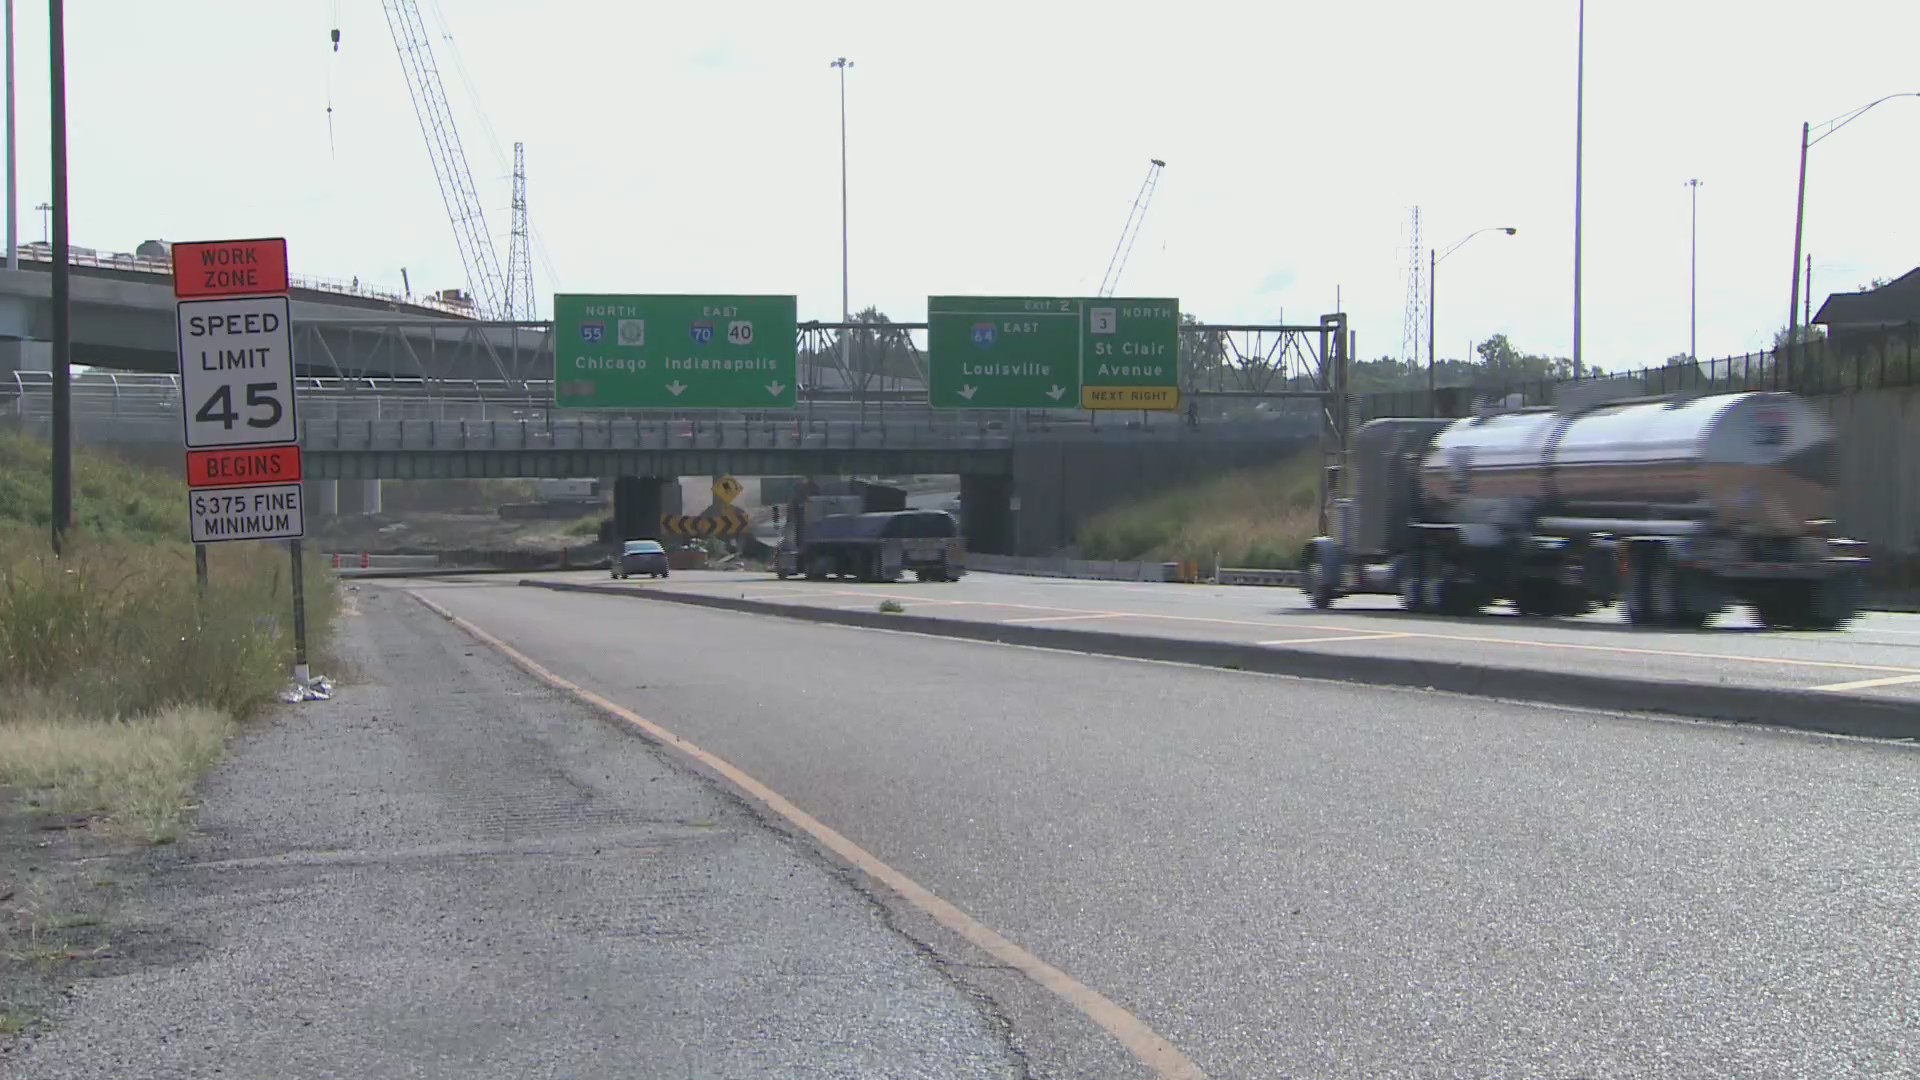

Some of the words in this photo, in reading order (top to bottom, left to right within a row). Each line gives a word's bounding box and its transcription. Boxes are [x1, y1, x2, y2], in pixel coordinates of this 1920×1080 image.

[201, 247, 257, 266] WORK
[204, 269, 258, 288] ZONE
[586, 306, 636, 317] NORTH
[703, 306, 738, 317] EAST
[1060, 300, 1071, 312] 2
[1122, 308, 1171, 318] NORTH
[190, 313, 279, 336] SPEED
[1003, 322, 1039, 333] EAST
[1099, 318, 1107, 330] 3
[583, 327, 601, 340] 55
[694, 328, 711, 341] 70
[729, 325, 751, 339] 40
[1095, 342, 1113, 355] St
[1122, 342, 1165, 355] Clair
[202, 347, 270, 371] LIMIT
[575, 356, 647, 374] Chicago
[664, 356, 777, 372] Indianapolis
[963, 362, 1051, 376] Louisville
[1098, 363, 1162, 376] Avenue
[1091, 391, 1124, 401] NEXT
[1131, 391, 1168, 401] RIGHT
[195, 382, 283, 430] 45
[207, 455, 281, 478] BEGINS
[195, 496, 246, 516] $375
[254, 493, 297, 512] FINE
[205, 514, 289, 535] MINIMUM
